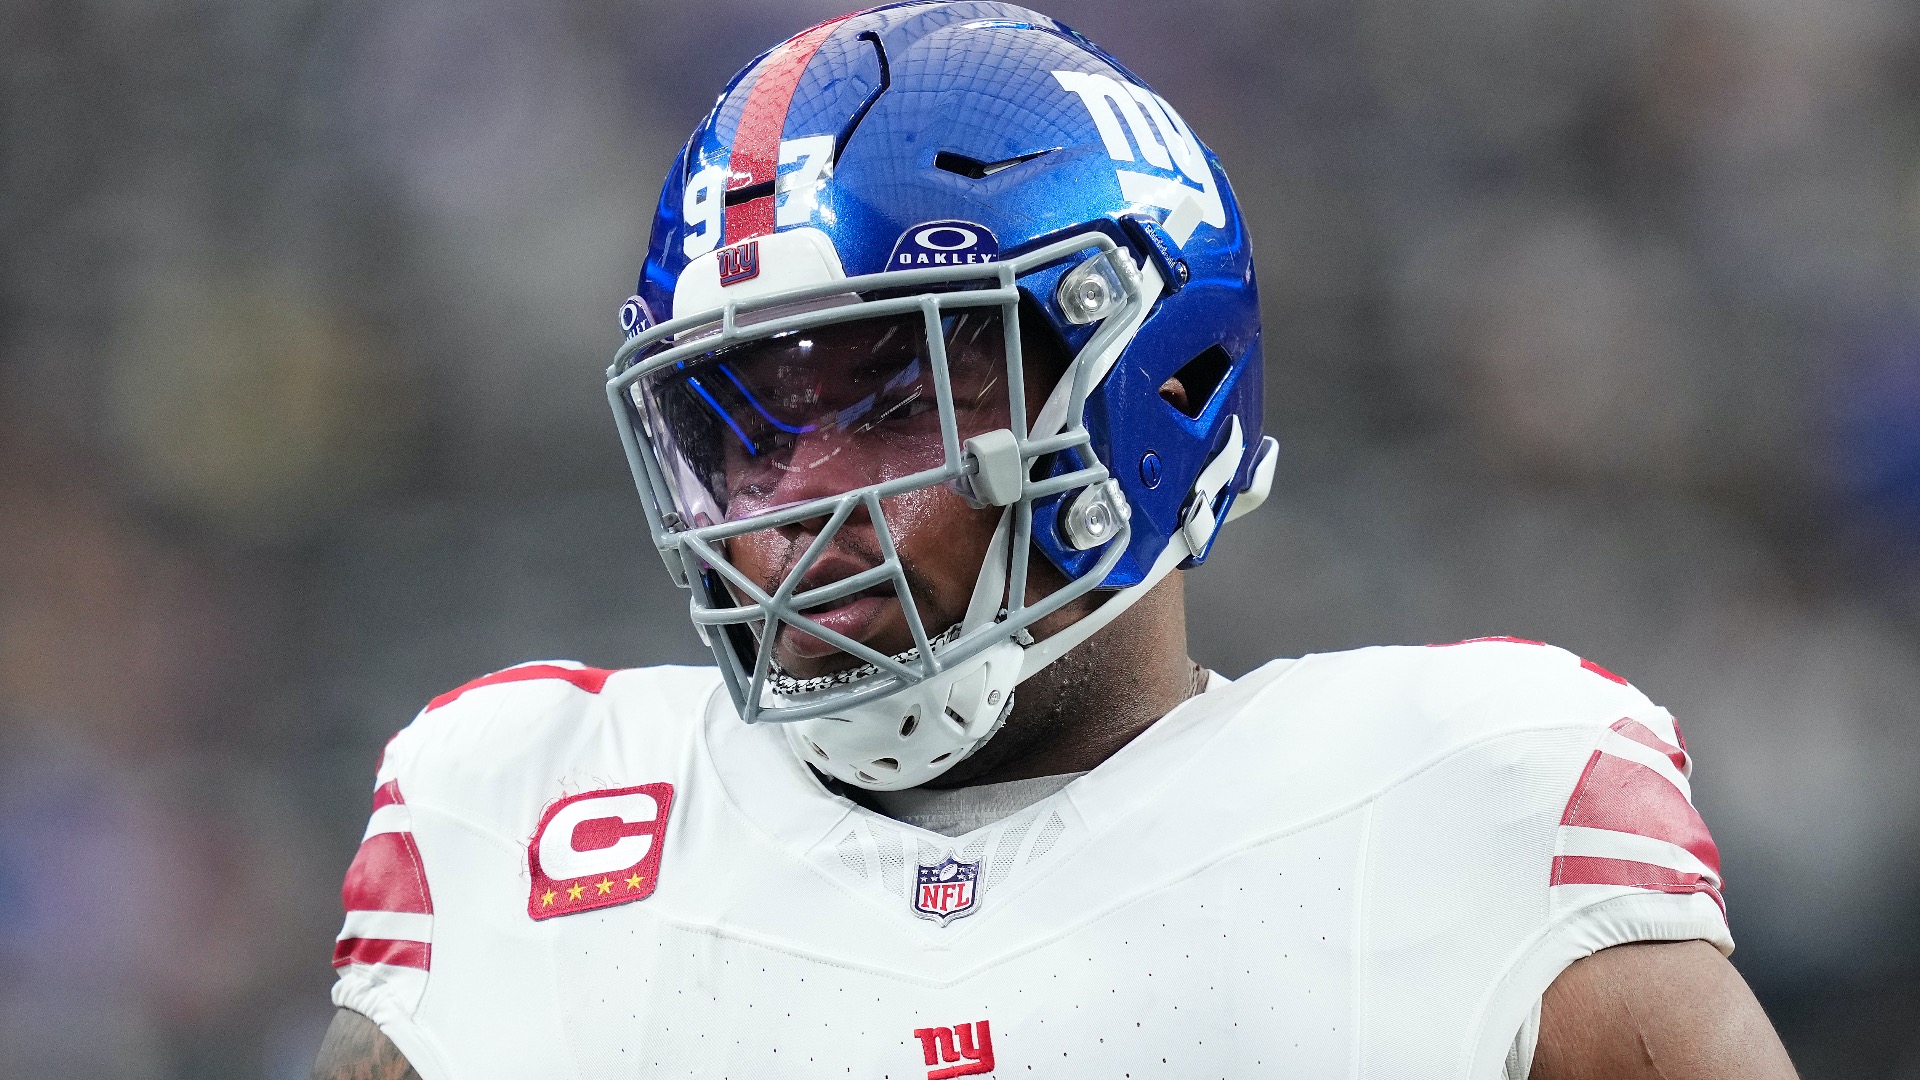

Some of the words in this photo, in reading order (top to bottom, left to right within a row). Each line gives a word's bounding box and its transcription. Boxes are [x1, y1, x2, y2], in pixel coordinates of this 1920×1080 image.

[716, 241, 760, 287] ny
[899, 252, 993, 264] OAKLEY
[538, 793, 658, 882] C
[920, 883, 970, 911] NFL
[913, 1019, 995, 1080] ny
